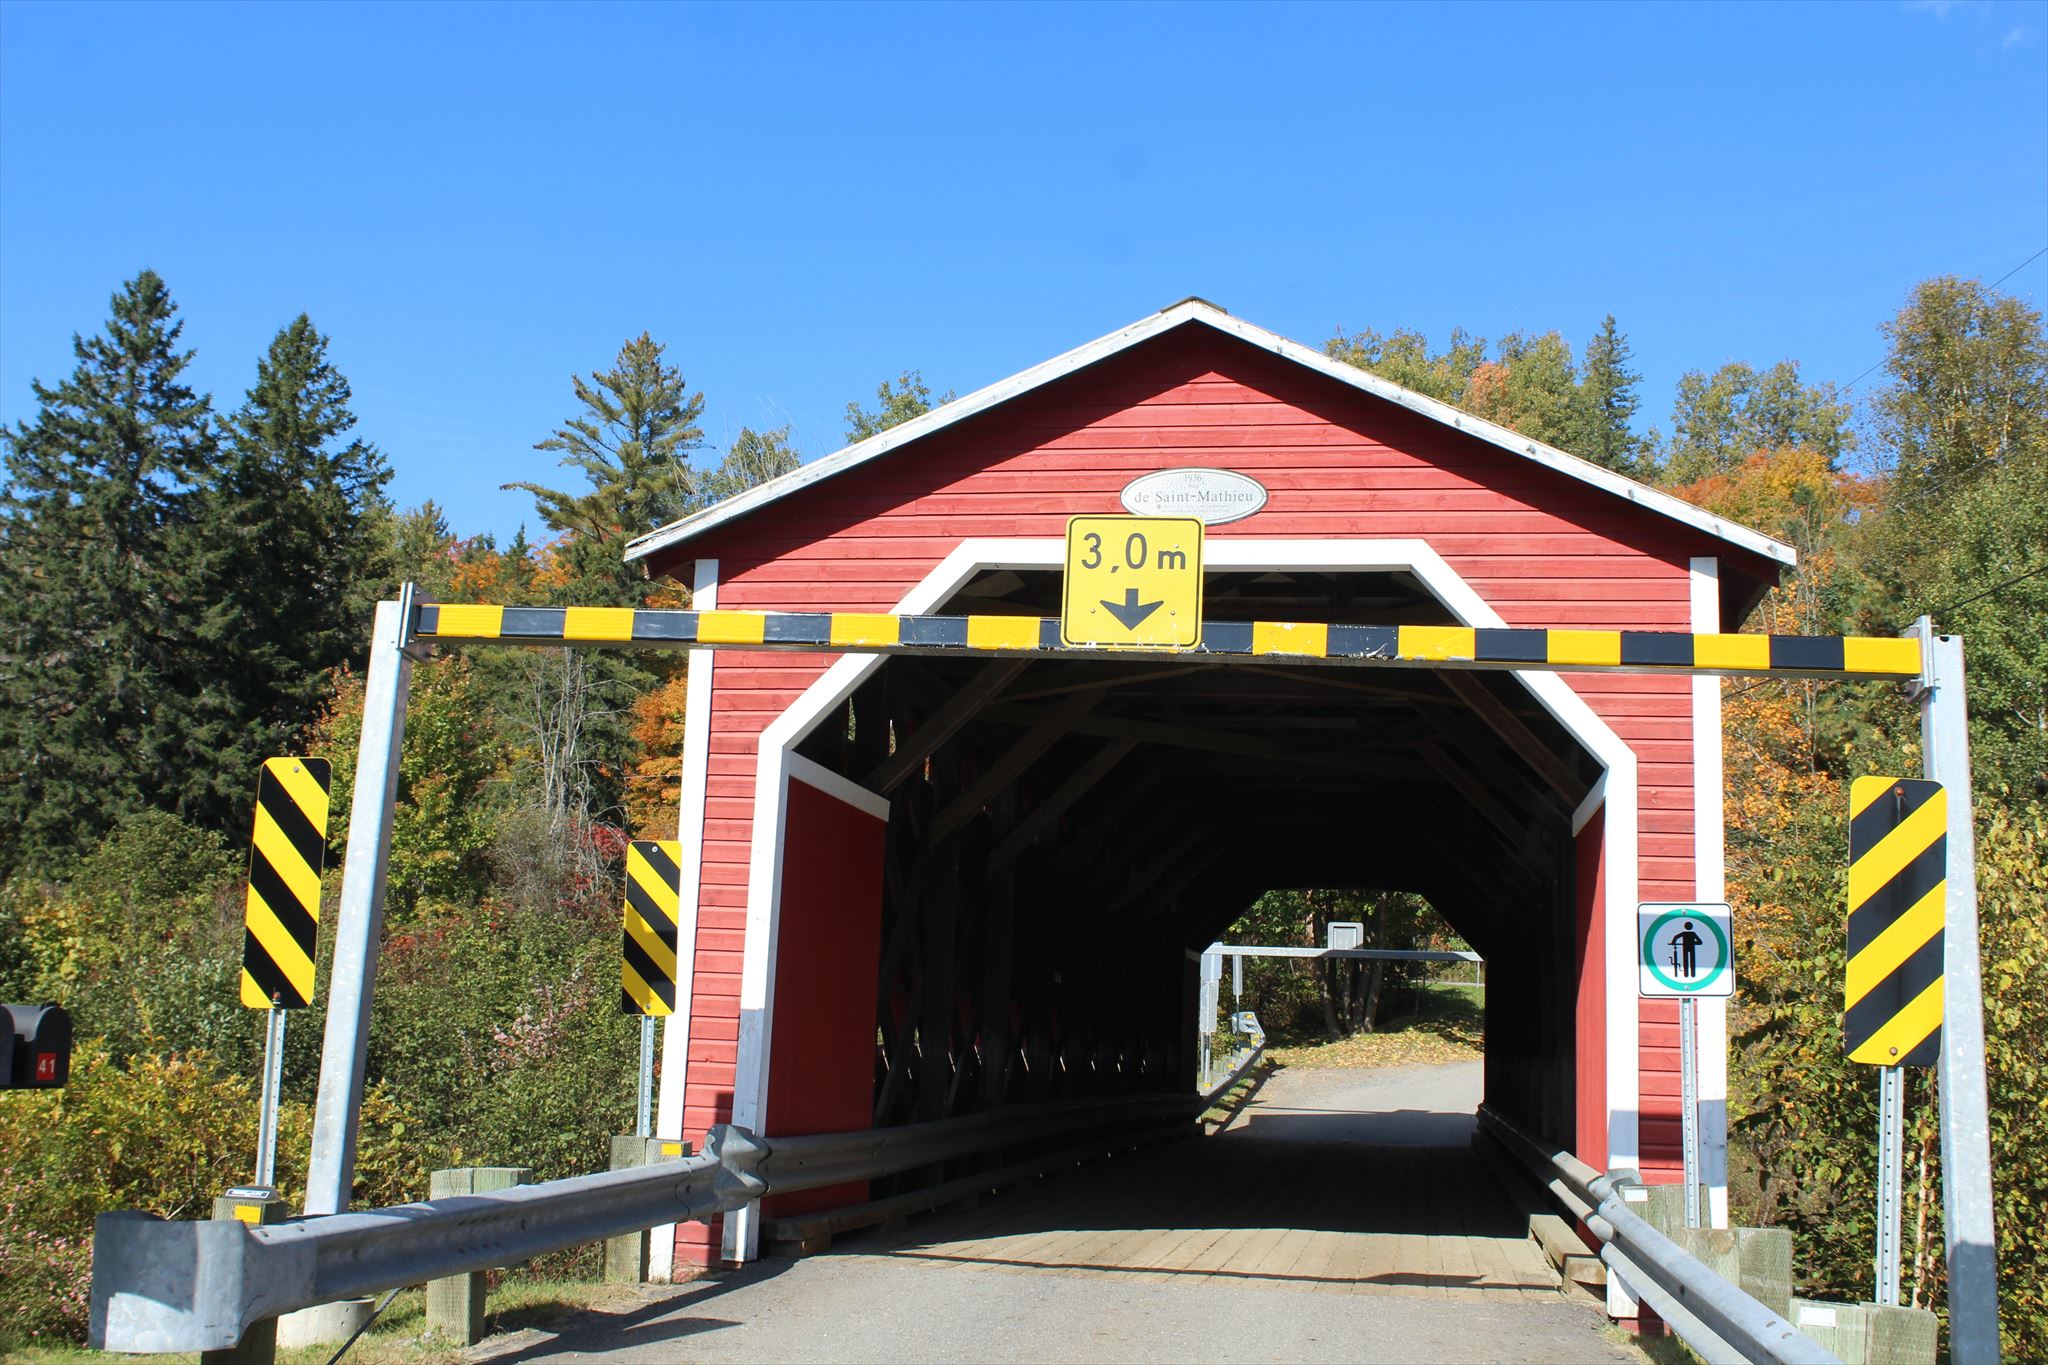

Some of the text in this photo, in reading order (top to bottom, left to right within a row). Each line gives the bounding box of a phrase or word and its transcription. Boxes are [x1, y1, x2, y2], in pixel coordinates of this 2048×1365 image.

[1134, 490, 1254, 503] de Saint-Mathieu
[1081, 532, 1187, 573] 3,0 m
[38, 1059, 56, 1073] 41
